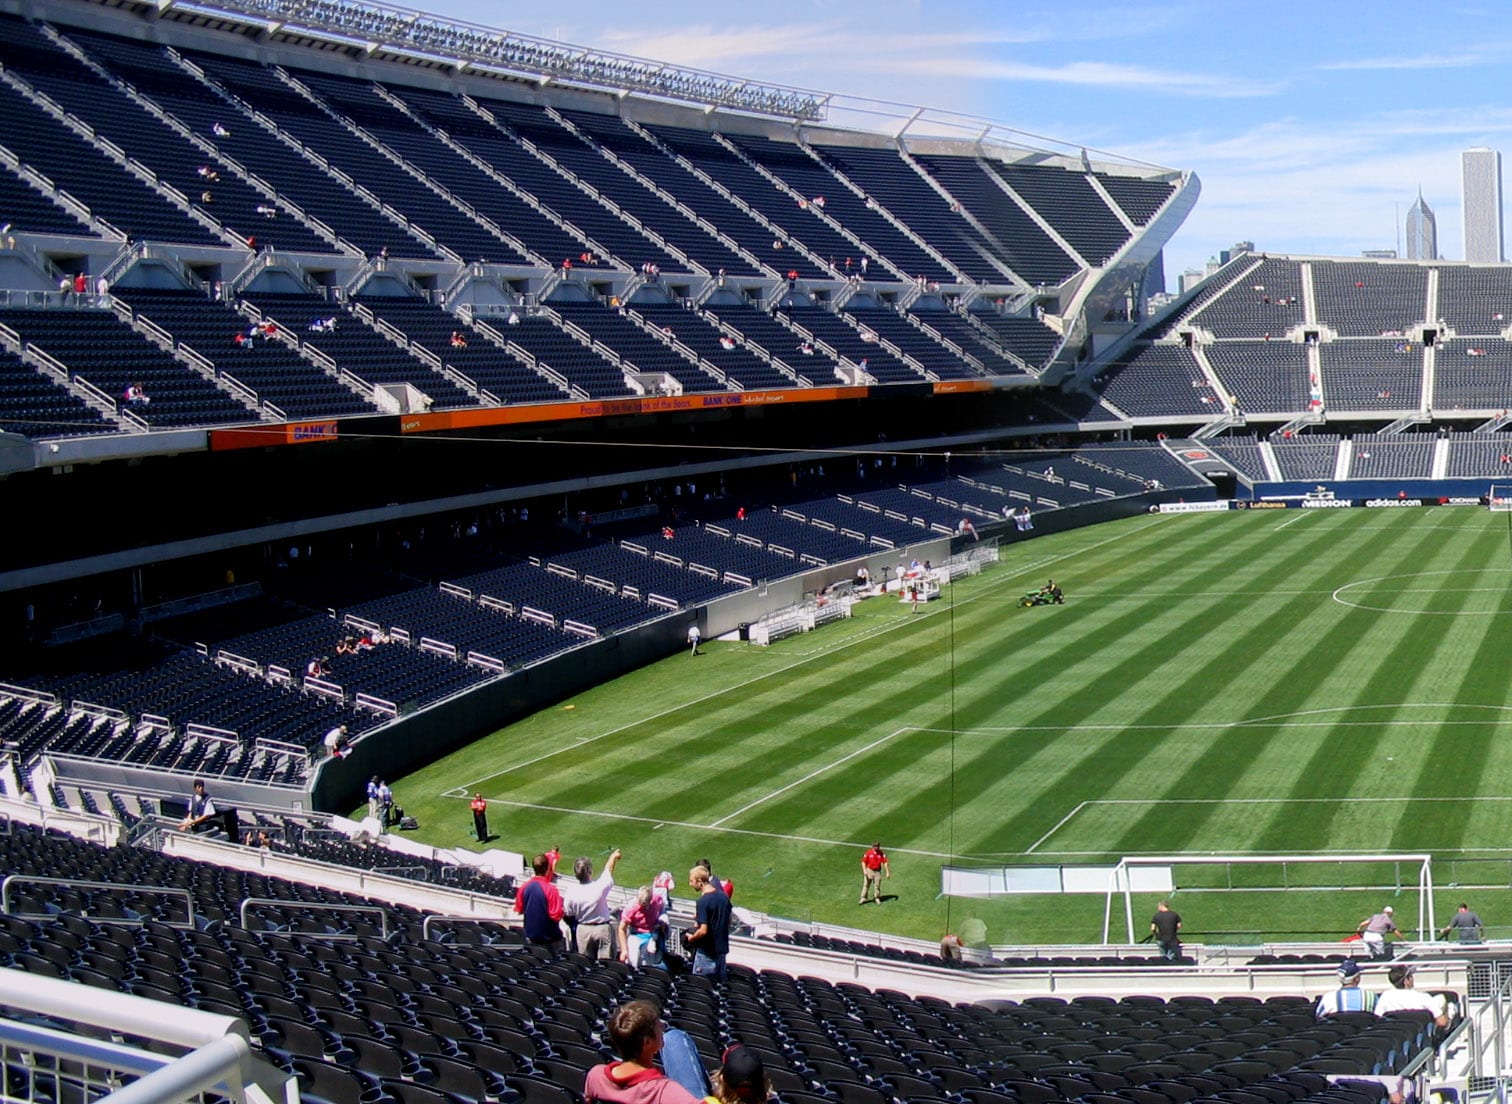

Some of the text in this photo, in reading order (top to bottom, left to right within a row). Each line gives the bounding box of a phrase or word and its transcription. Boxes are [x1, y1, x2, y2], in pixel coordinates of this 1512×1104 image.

[294, 422, 326, 440] BANK
[1249, 501, 1286, 509] Lufthansa
[1366, 499, 1422, 507] adidas.com
